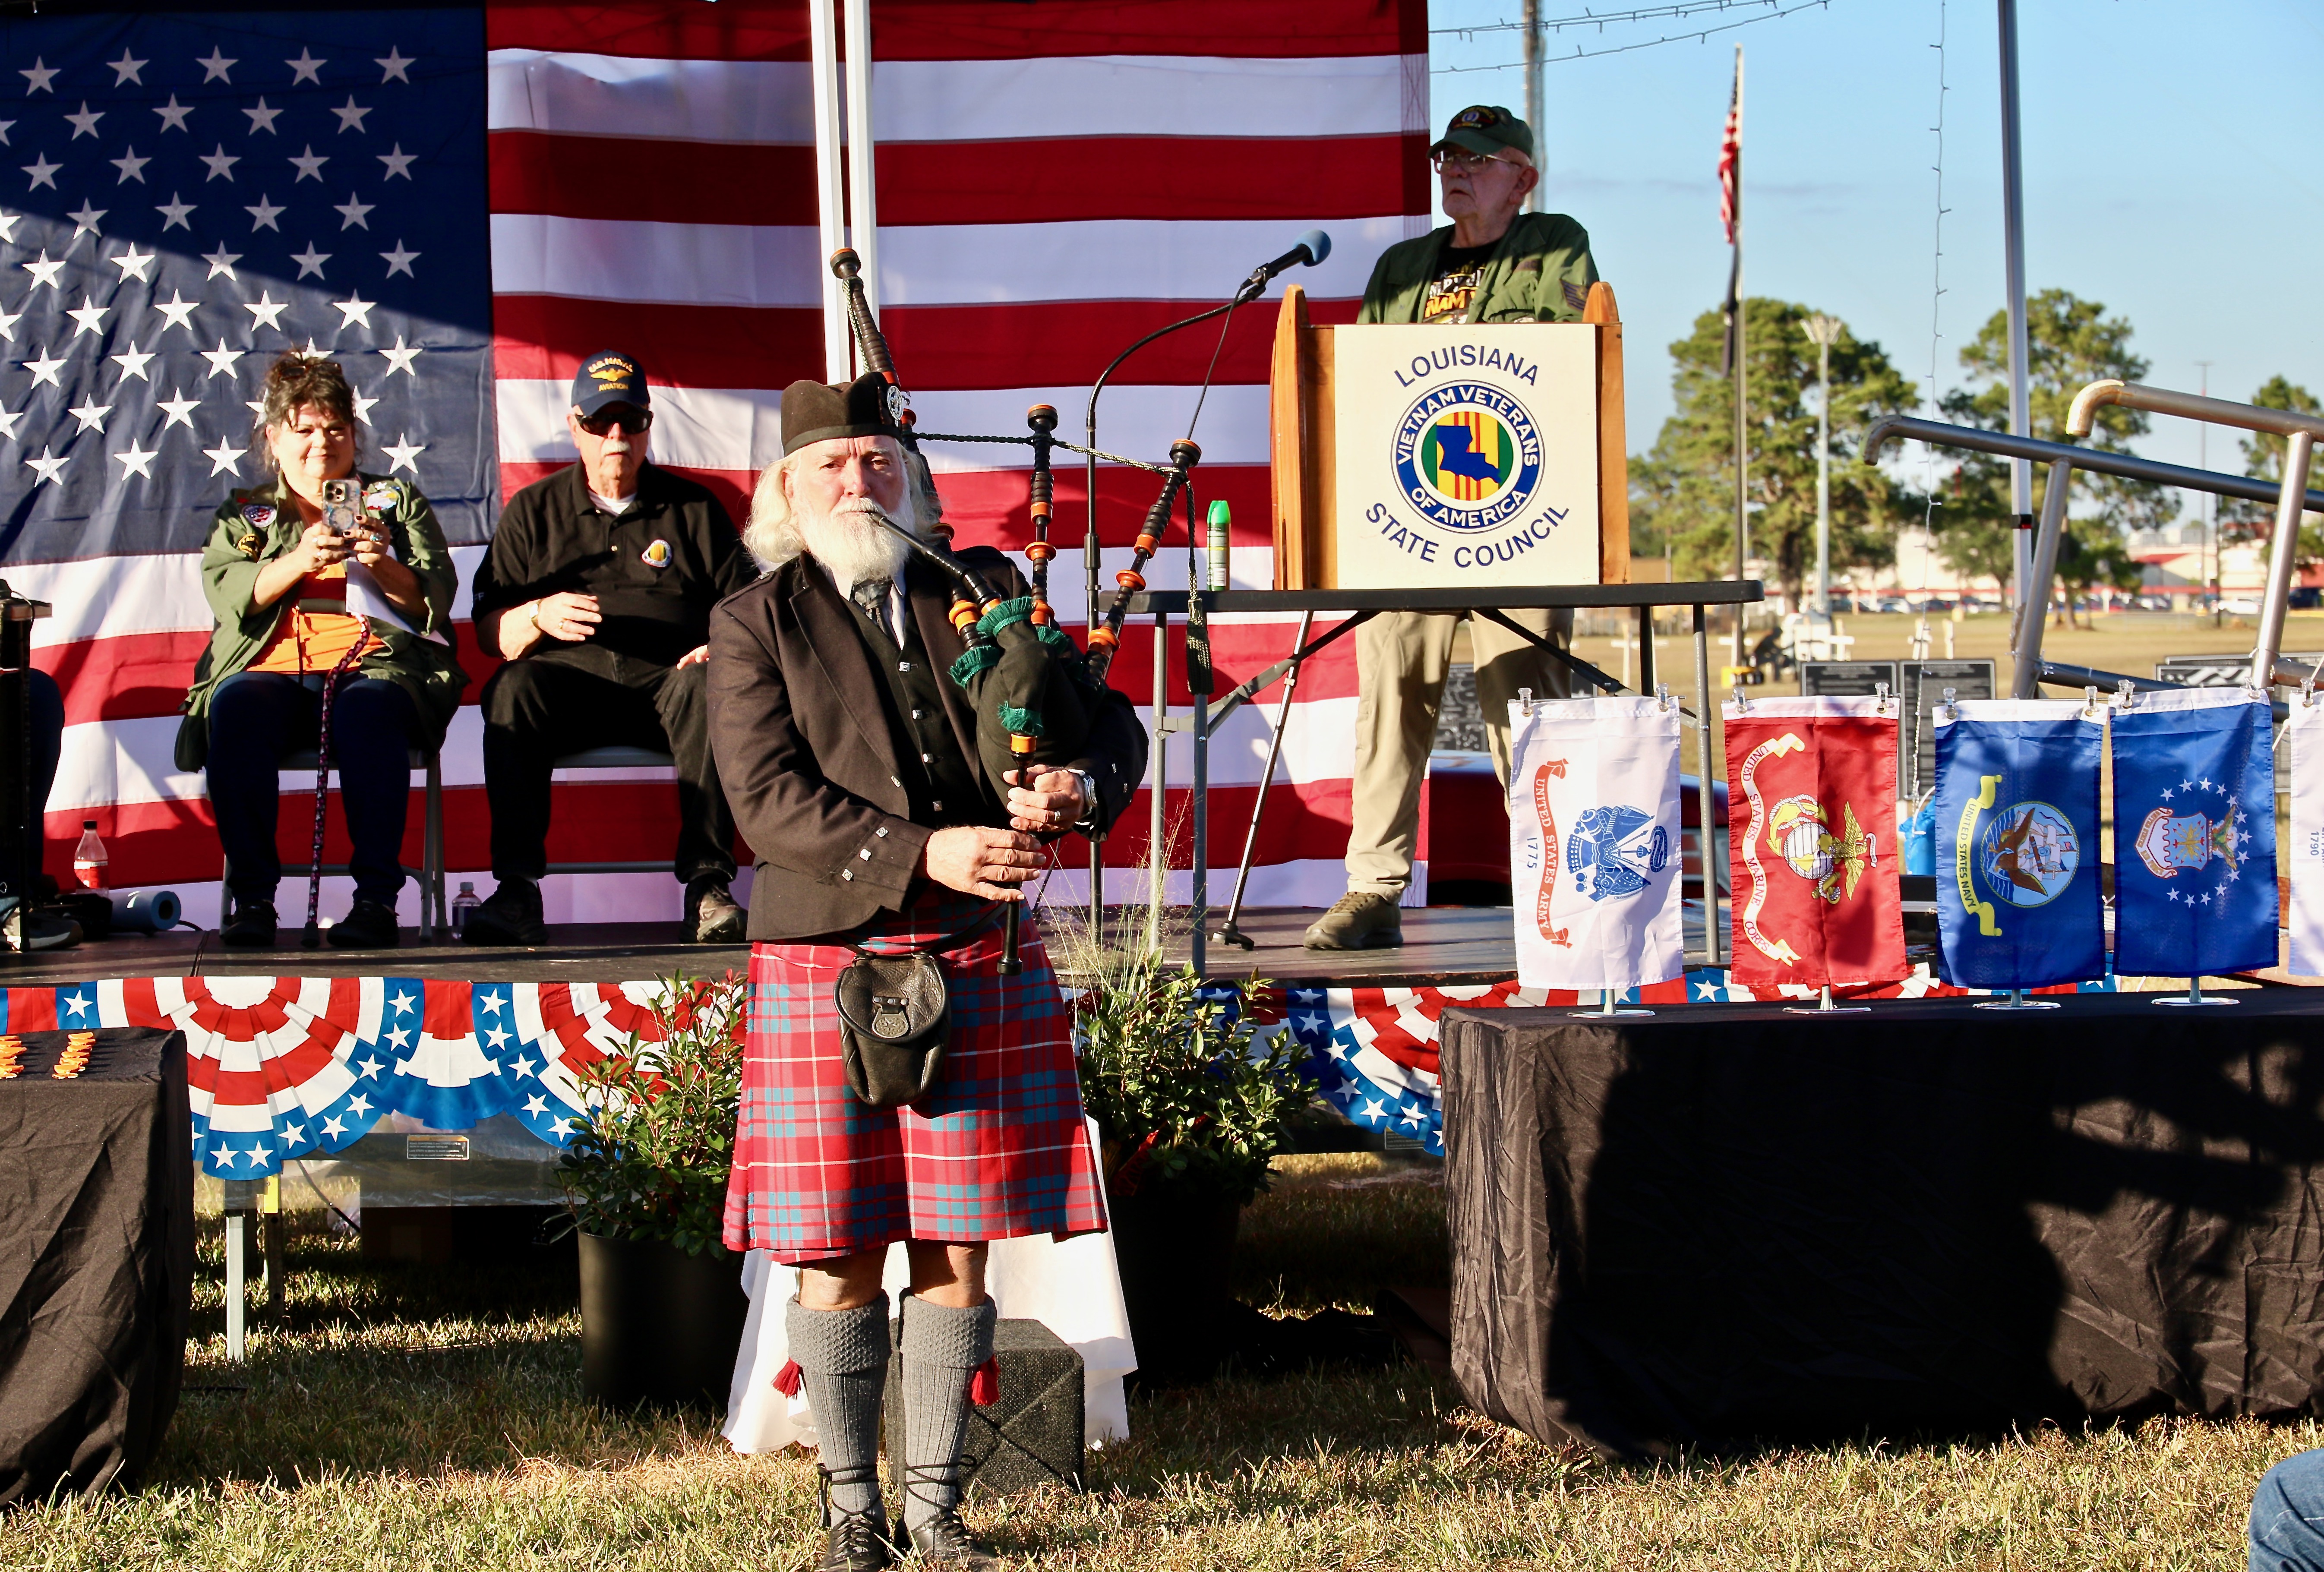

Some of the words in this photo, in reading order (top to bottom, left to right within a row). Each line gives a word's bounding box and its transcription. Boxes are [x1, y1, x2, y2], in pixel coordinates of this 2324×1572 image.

[1394, 344, 1539, 388] LOUISIANA
[598, 382, 628, 392] AVIATION
[1398, 388, 1456, 466] VIETNAM
[1459, 386, 1538, 467] VETERANS
[1411, 487, 1437, 509] OF
[1434, 489, 1527, 527] AMERICA
[1366, 503, 1439, 563] STATE
[1453, 506, 1569, 568] COUNCIL
[1743, 745, 1770, 782] UNITED
[1535, 779, 1551, 827] UNITED
[1746, 793, 1762, 841] STATES
[1960, 803, 1977, 841] UNITED
[1527, 837, 1538, 868] 1775
[1545, 834, 1557, 884] STATES
[1959, 843, 1968, 879] STATES
[2310, 831, 2319, 856] 1790
[1746, 857, 1765, 906] MARINE
[1961, 881, 1977, 907] NAVY
[1538, 891, 1550, 929] ARMY
[1745, 921, 1770, 951] CORPS
